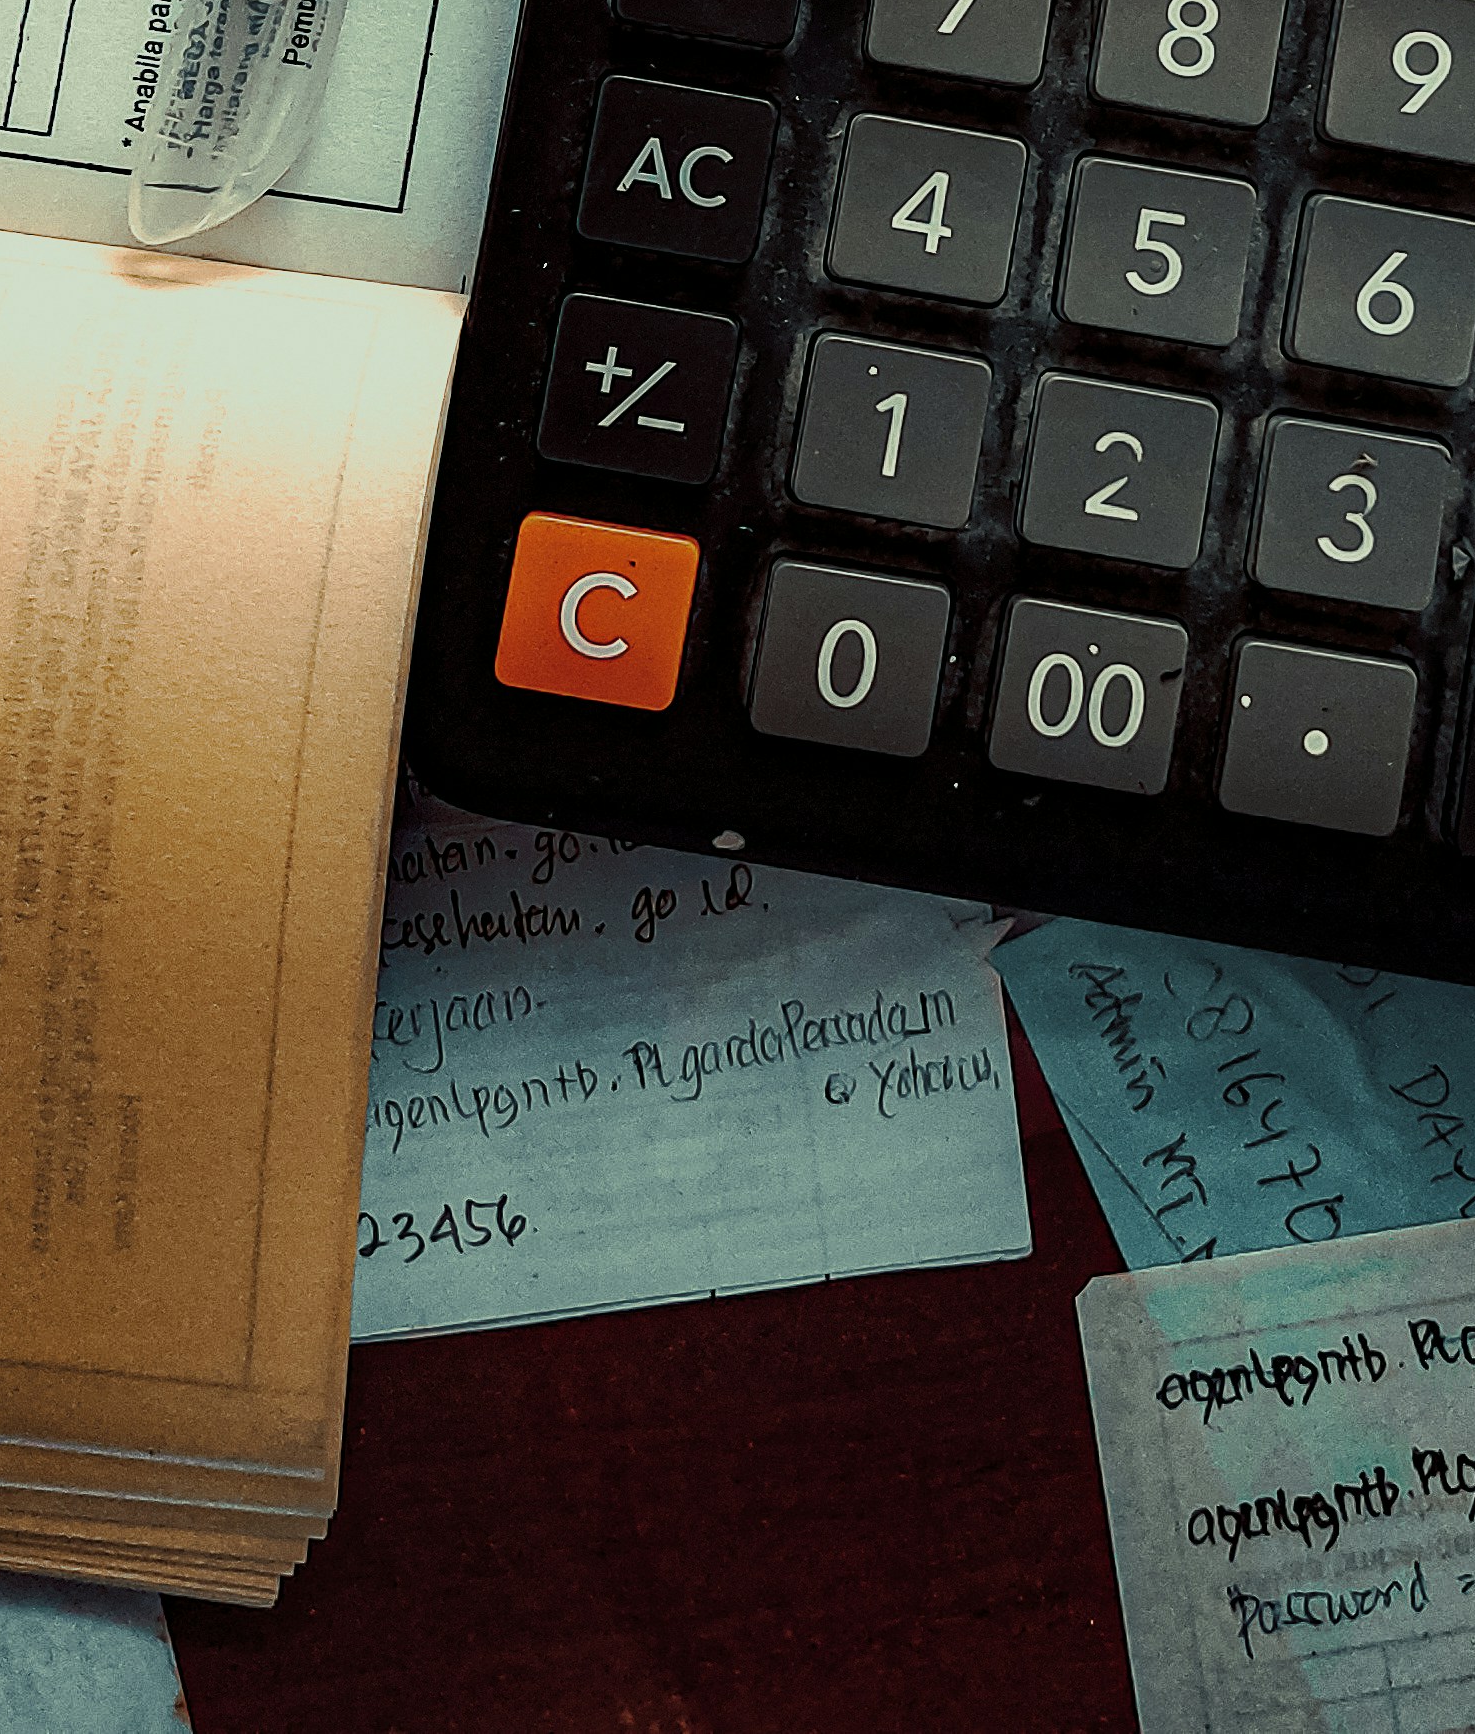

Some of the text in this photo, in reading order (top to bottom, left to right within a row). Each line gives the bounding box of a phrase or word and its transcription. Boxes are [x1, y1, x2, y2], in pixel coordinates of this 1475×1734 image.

[1393, 32, 1451, 113] 9
[617, 137, 733, 207] AC
[892, 172, 951, 253] 4
[1126, 209, 1185, 294] 5
[1357, 253, 1414, 334] 6
[876, 394, 906, 476] 1
[1085, 432, 1142, 520] 2
[1318, 475, 1376, 562] 3
[561, 573, 637, 658] C
[818, 620, 876, 707] 0
[1028, 650, 1144, 746] 00
